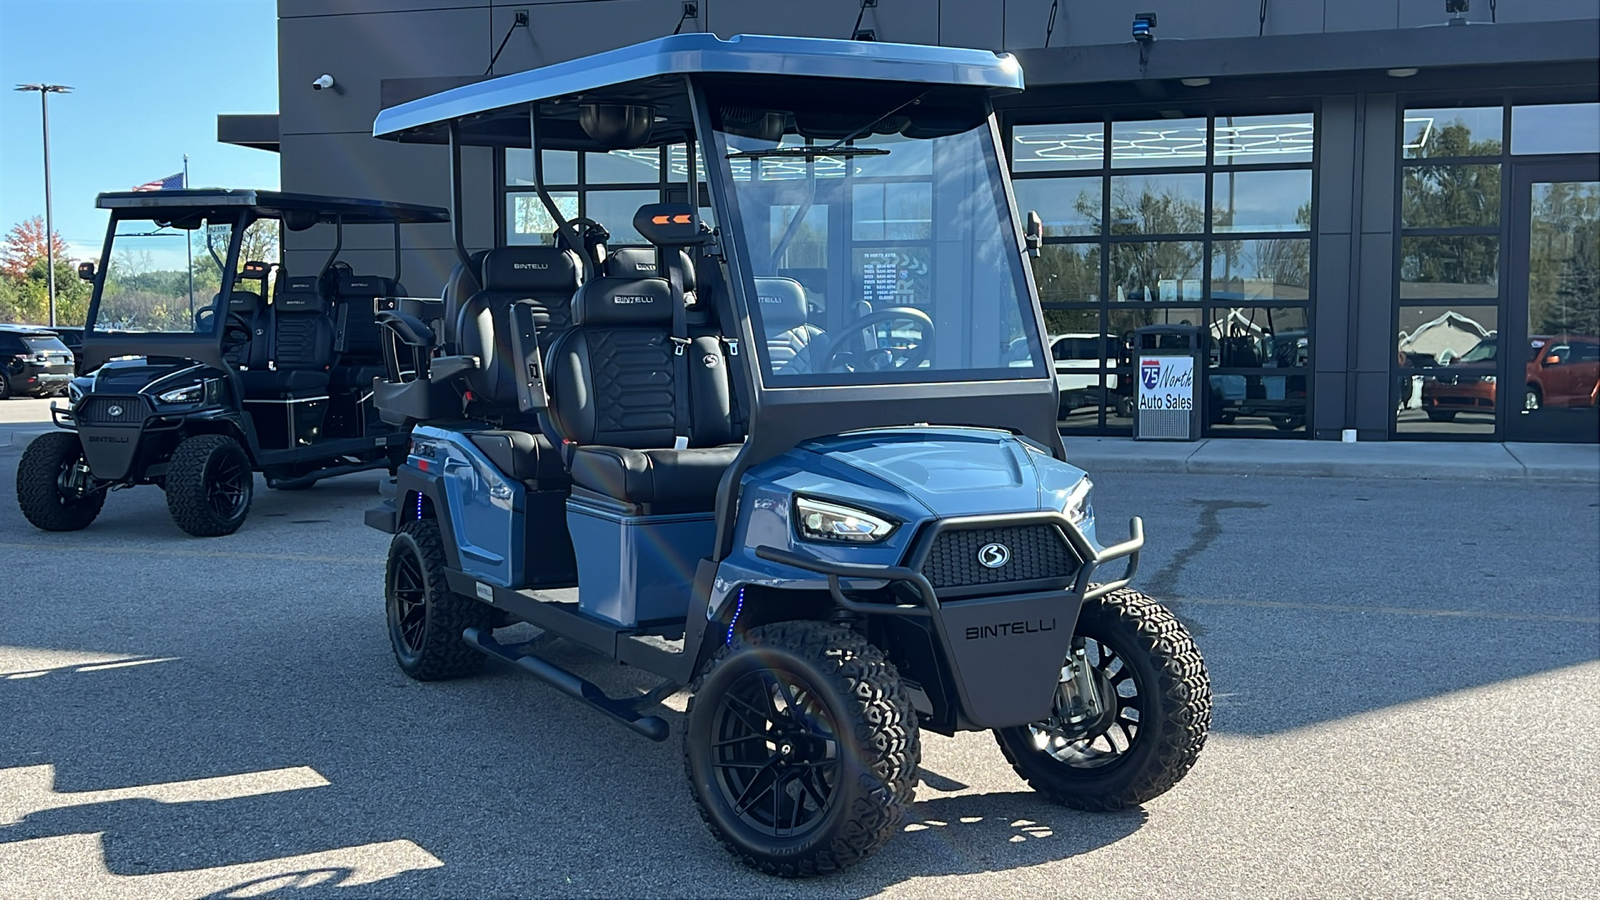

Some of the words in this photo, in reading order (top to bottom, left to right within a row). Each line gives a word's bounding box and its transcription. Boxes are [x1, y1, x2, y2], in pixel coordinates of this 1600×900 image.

[758, 296, 782, 304] TELLI
[1144, 368, 1158, 384] 75
[1159, 364, 1193, 389] North
[1140, 393, 1163, 409] Auto
[1165, 393, 1192, 409] Sales
[88, 435, 129, 443] BINTELLI
[966, 618, 1056, 640] BINTELLI
